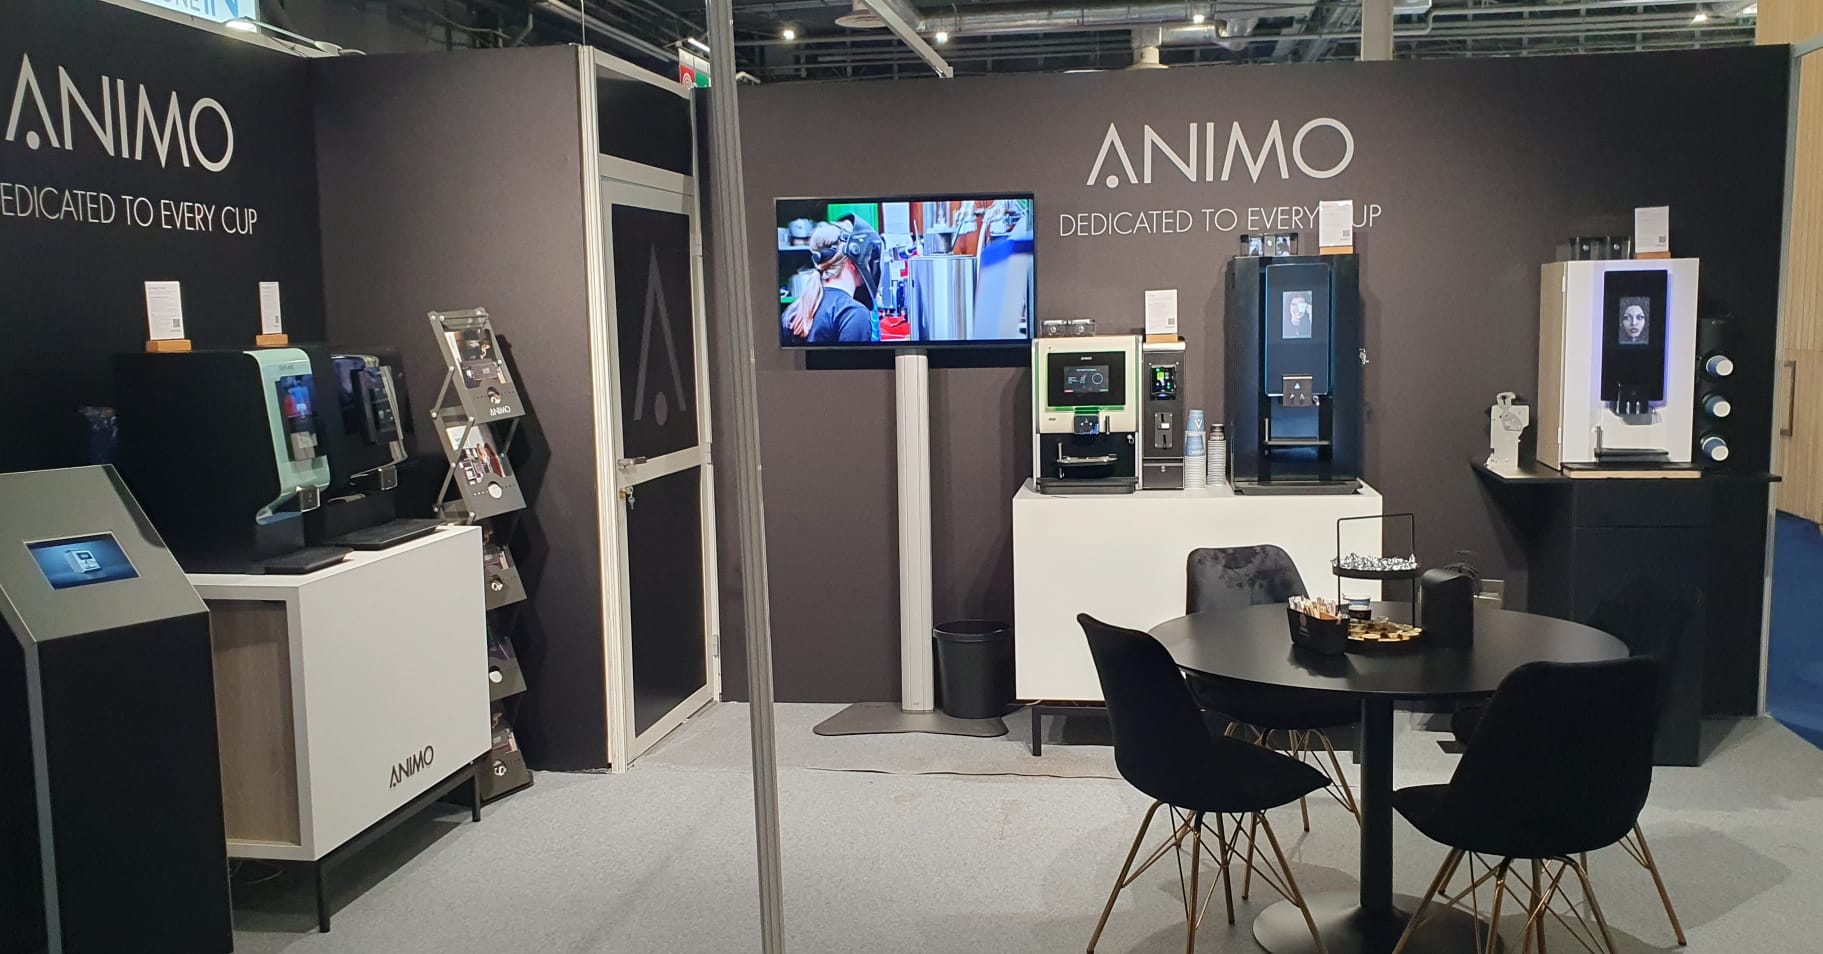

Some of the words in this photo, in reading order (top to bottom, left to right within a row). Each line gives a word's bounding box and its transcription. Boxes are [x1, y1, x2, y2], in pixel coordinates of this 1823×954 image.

[5, 52, 234, 173] ANIMO
[1086, 117, 1355, 189] ANIMO
[0, 182, 116, 224] EDICATED
[121, 195, 154, 227] TO
[160, 199, 216, 232] EVERY
[221, 206, 258, 235] CUP
[1059, 209, 1193, 237] DEDICATED
[1201, 208, 1238, 232] TO
[1247, 206, 1319, 231] EVERY
[1352, 204, 1383, 229] UP
[389, 745, 435, 789] ANIMO
